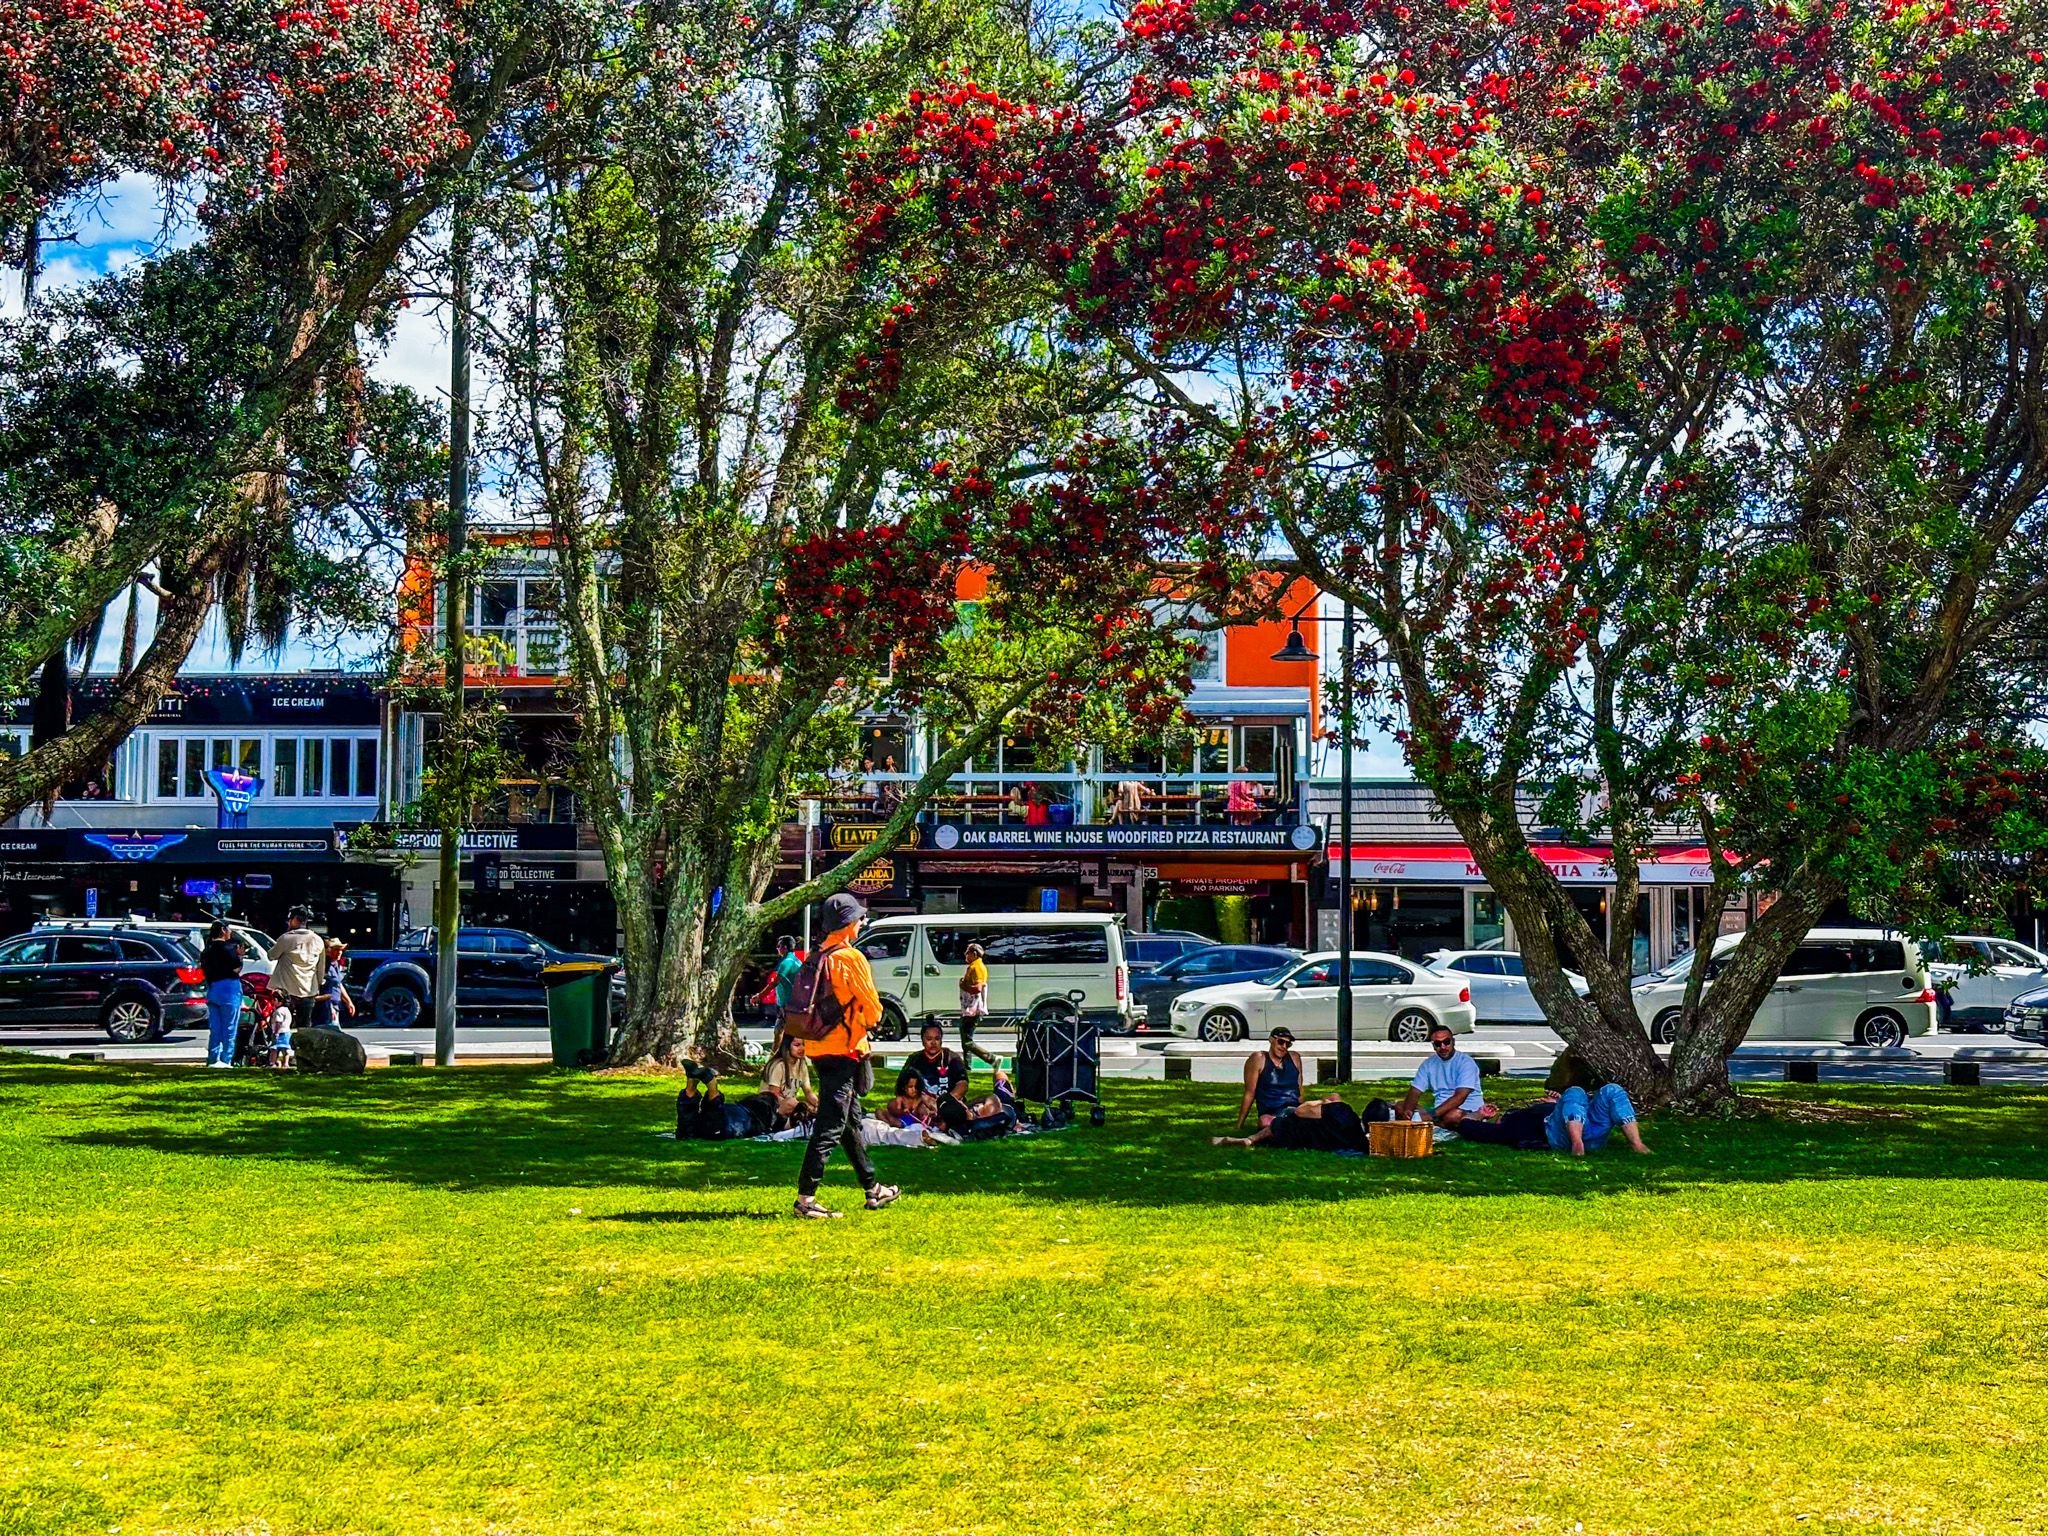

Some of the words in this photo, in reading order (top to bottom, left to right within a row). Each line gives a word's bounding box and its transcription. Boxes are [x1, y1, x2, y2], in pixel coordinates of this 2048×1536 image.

[272, 698, 290, 707] ICE
[291, 698, 324, 707] CREAM
[458, 834, 518, 848] OLLECTIVE
[844, 830, 858, 844] LA
[962, 831, 987, 843] OAK
[988, 831, 1031, 843] BARREL
[1033, 831, 1062, 844] WINE
[1065, 831, 1103, 844] HOUSE
[1107, 831, 1173, 844] WOODFIRED
[1176, 831, 1210, 844] PIZZA
[1212, 831, 1286, 844] RESTAURANT
[510, 870, 555, 880] COLLECTIVE
[859, 868, 889, 879] RANDA
[1143, 868, 1157, 878] 55
